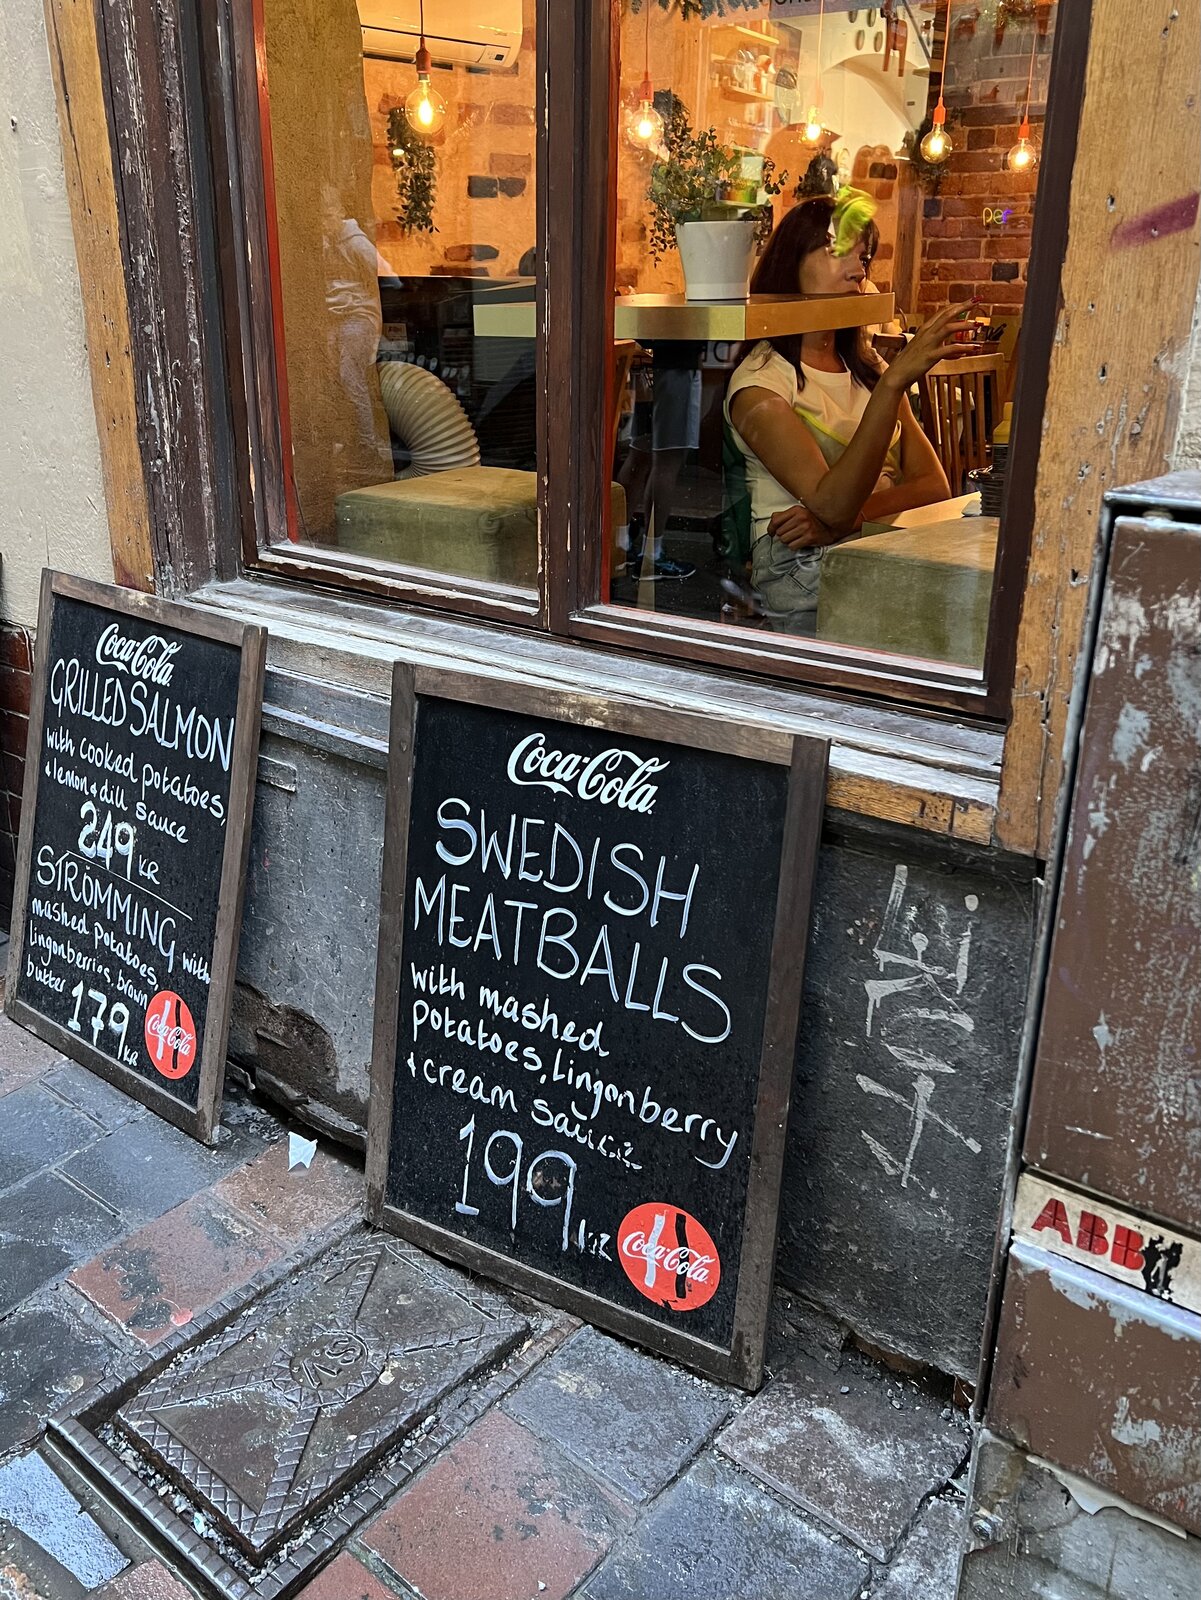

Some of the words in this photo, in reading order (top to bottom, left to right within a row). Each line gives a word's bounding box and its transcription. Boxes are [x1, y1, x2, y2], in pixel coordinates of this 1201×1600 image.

[96, 623, 182, 687] Coca-Cola
[51, 658, 127, 728] GRILLED
[130, 681, 235, 772] SALMON
[46, 725, 75, 757] with
[79, 737, 139, 783] cooked
[507, 732, 671, 815] Coca-Cola
[78, 800, 138, 880] 249
[99, 778, 128, 811] dill
[135, 801, 189, 844] sauce
[435, 797, 700, 939] SWEDISH
[32, 897, 90, 935] mashed
[36, 845, 177, 973] STRÖMMING
[182, 952, 211, 985] with
[26, 953, 67, 993] butter
[116, 969, 148, 1010] brown
[413, 873, 734, 1044] MEATBALLS
[67, 979, 130, 1060] 179
[147, 1013, 194, 1056] Coca-Cola
[410, 961, 466, 1000] with
[479, 984, 610, 1057] mashed
[422, 1058, 519, 1113] cream
[455, 1113, 578, 1251] 199
[622, 1230, 717, 1285] Coca-Cola
[1031, 1198, 1146, 1271] ABB
